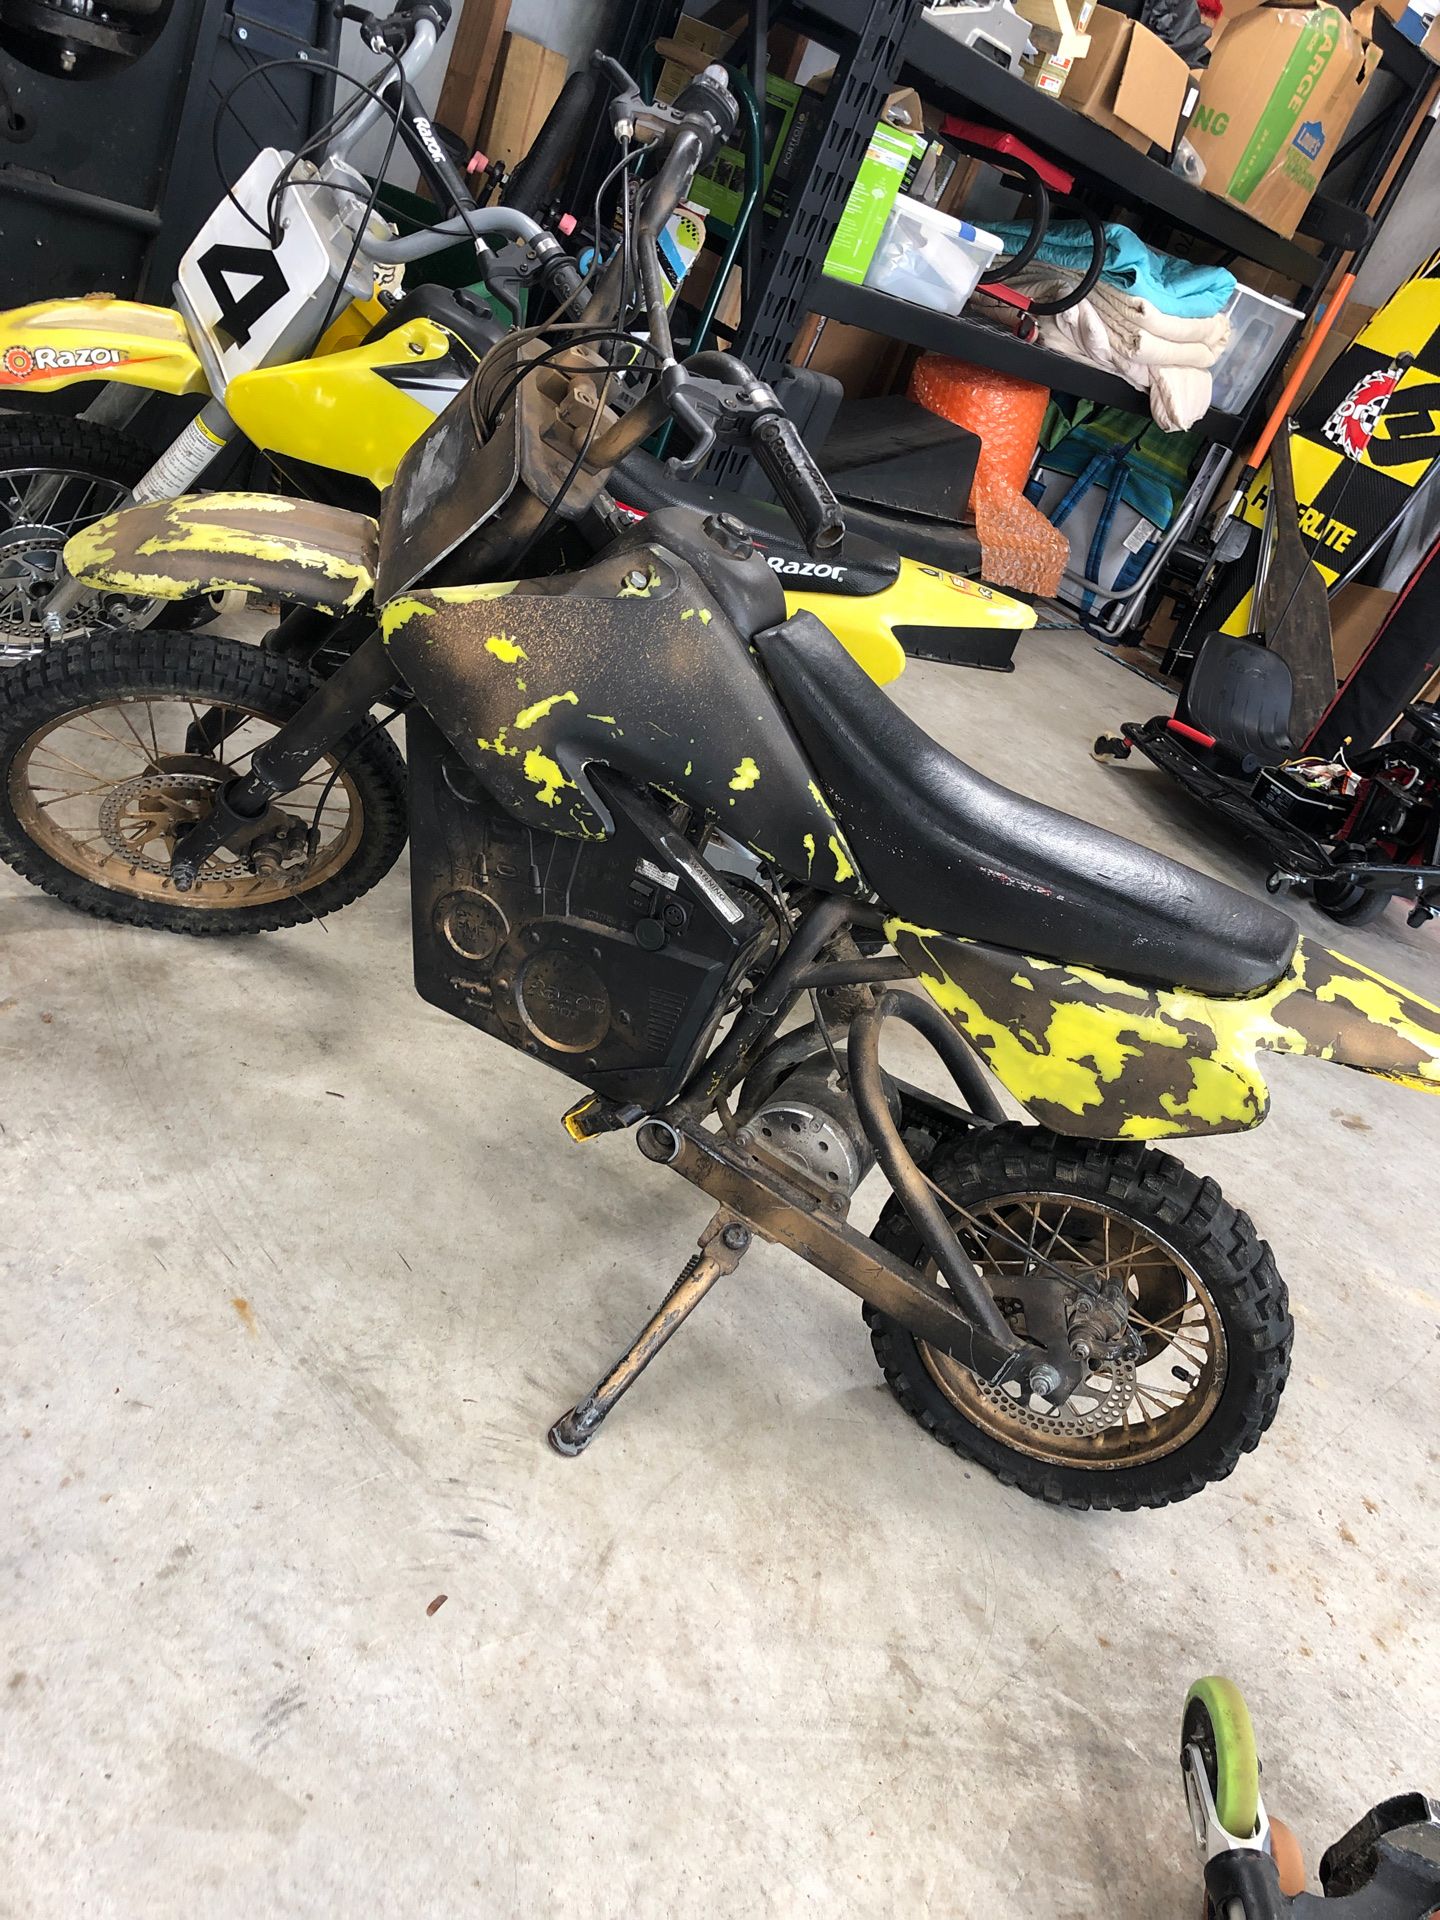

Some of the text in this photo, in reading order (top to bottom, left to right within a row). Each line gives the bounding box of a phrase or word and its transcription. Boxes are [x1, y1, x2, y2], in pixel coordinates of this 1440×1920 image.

[1287, 17, 1339, 114] LARGE
[412, 116, 446, 163] Razor
[196, 243, 291, 354] 4
[1251, 484, 1357, 554] HERLITE
[767, 556, 848, 583] Razor
[691, 859, 726, 901] WARNING
